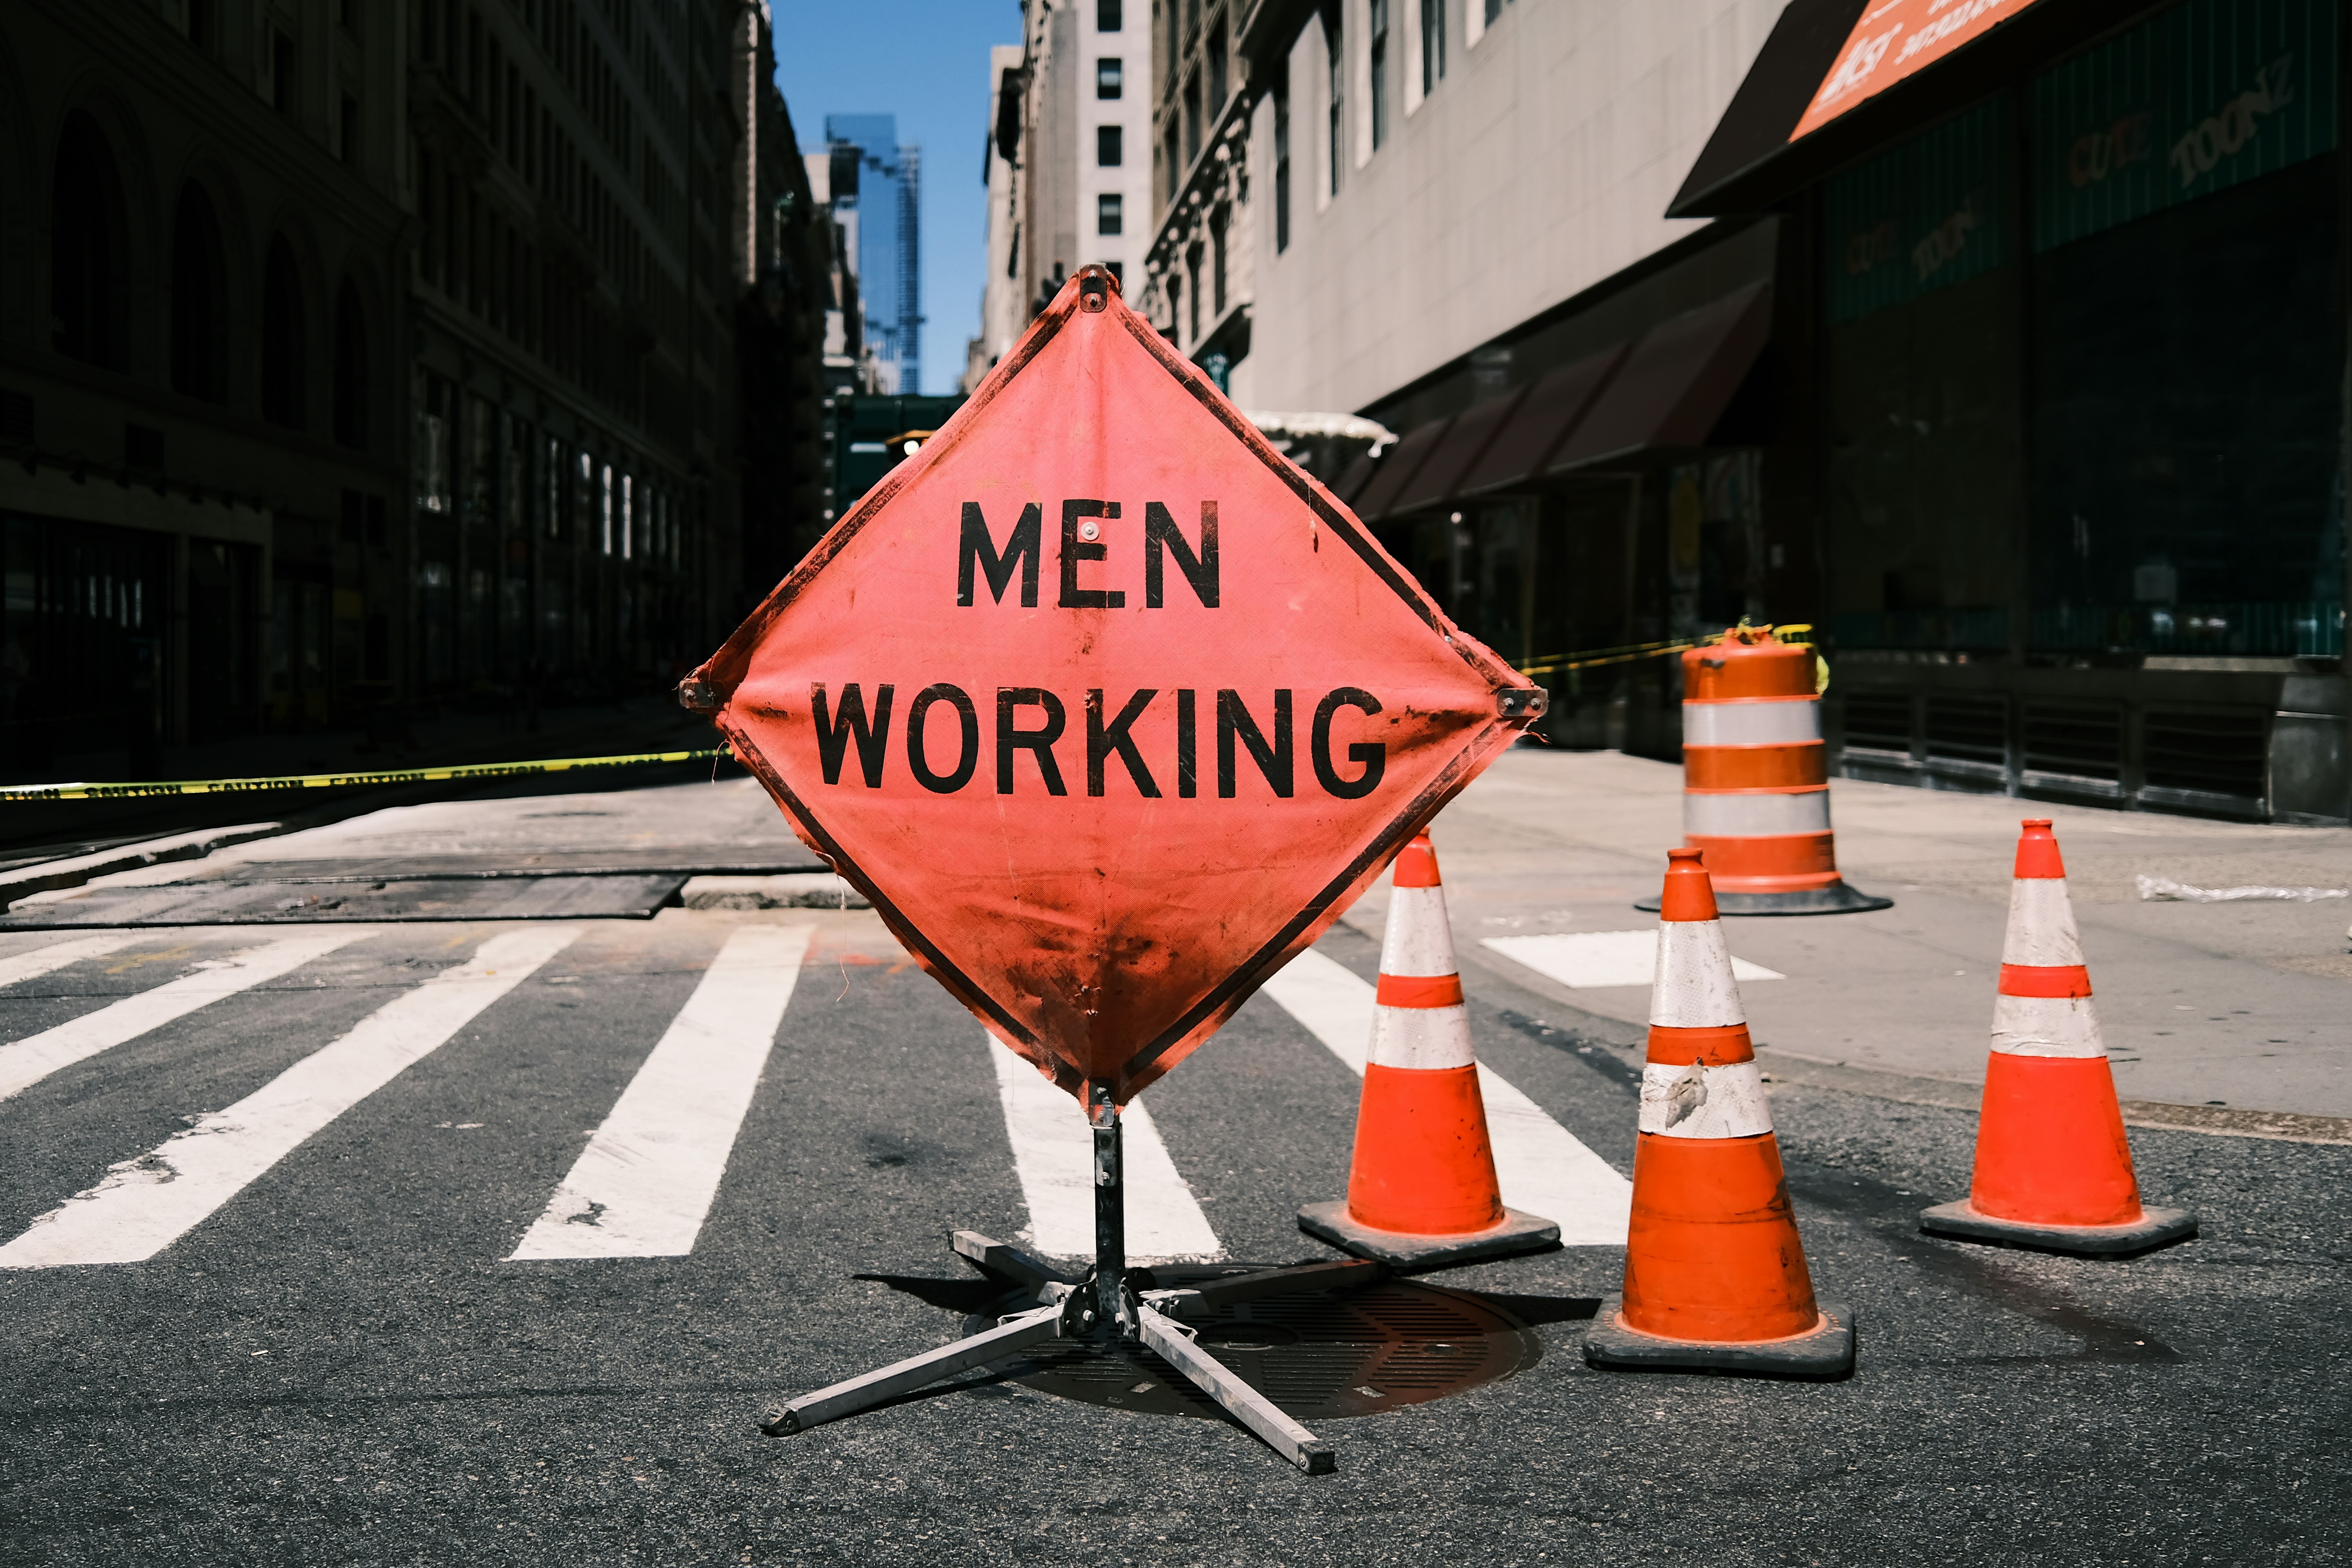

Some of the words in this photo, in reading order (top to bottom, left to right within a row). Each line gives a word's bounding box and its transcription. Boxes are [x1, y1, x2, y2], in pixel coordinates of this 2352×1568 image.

[2069, 109, 2151, 188] CUTE
[2170, 52, 2294, 188] TOONZ
[957, 499, 1220, 609] MEN
[811, 682, 1386, 799] WORKING
